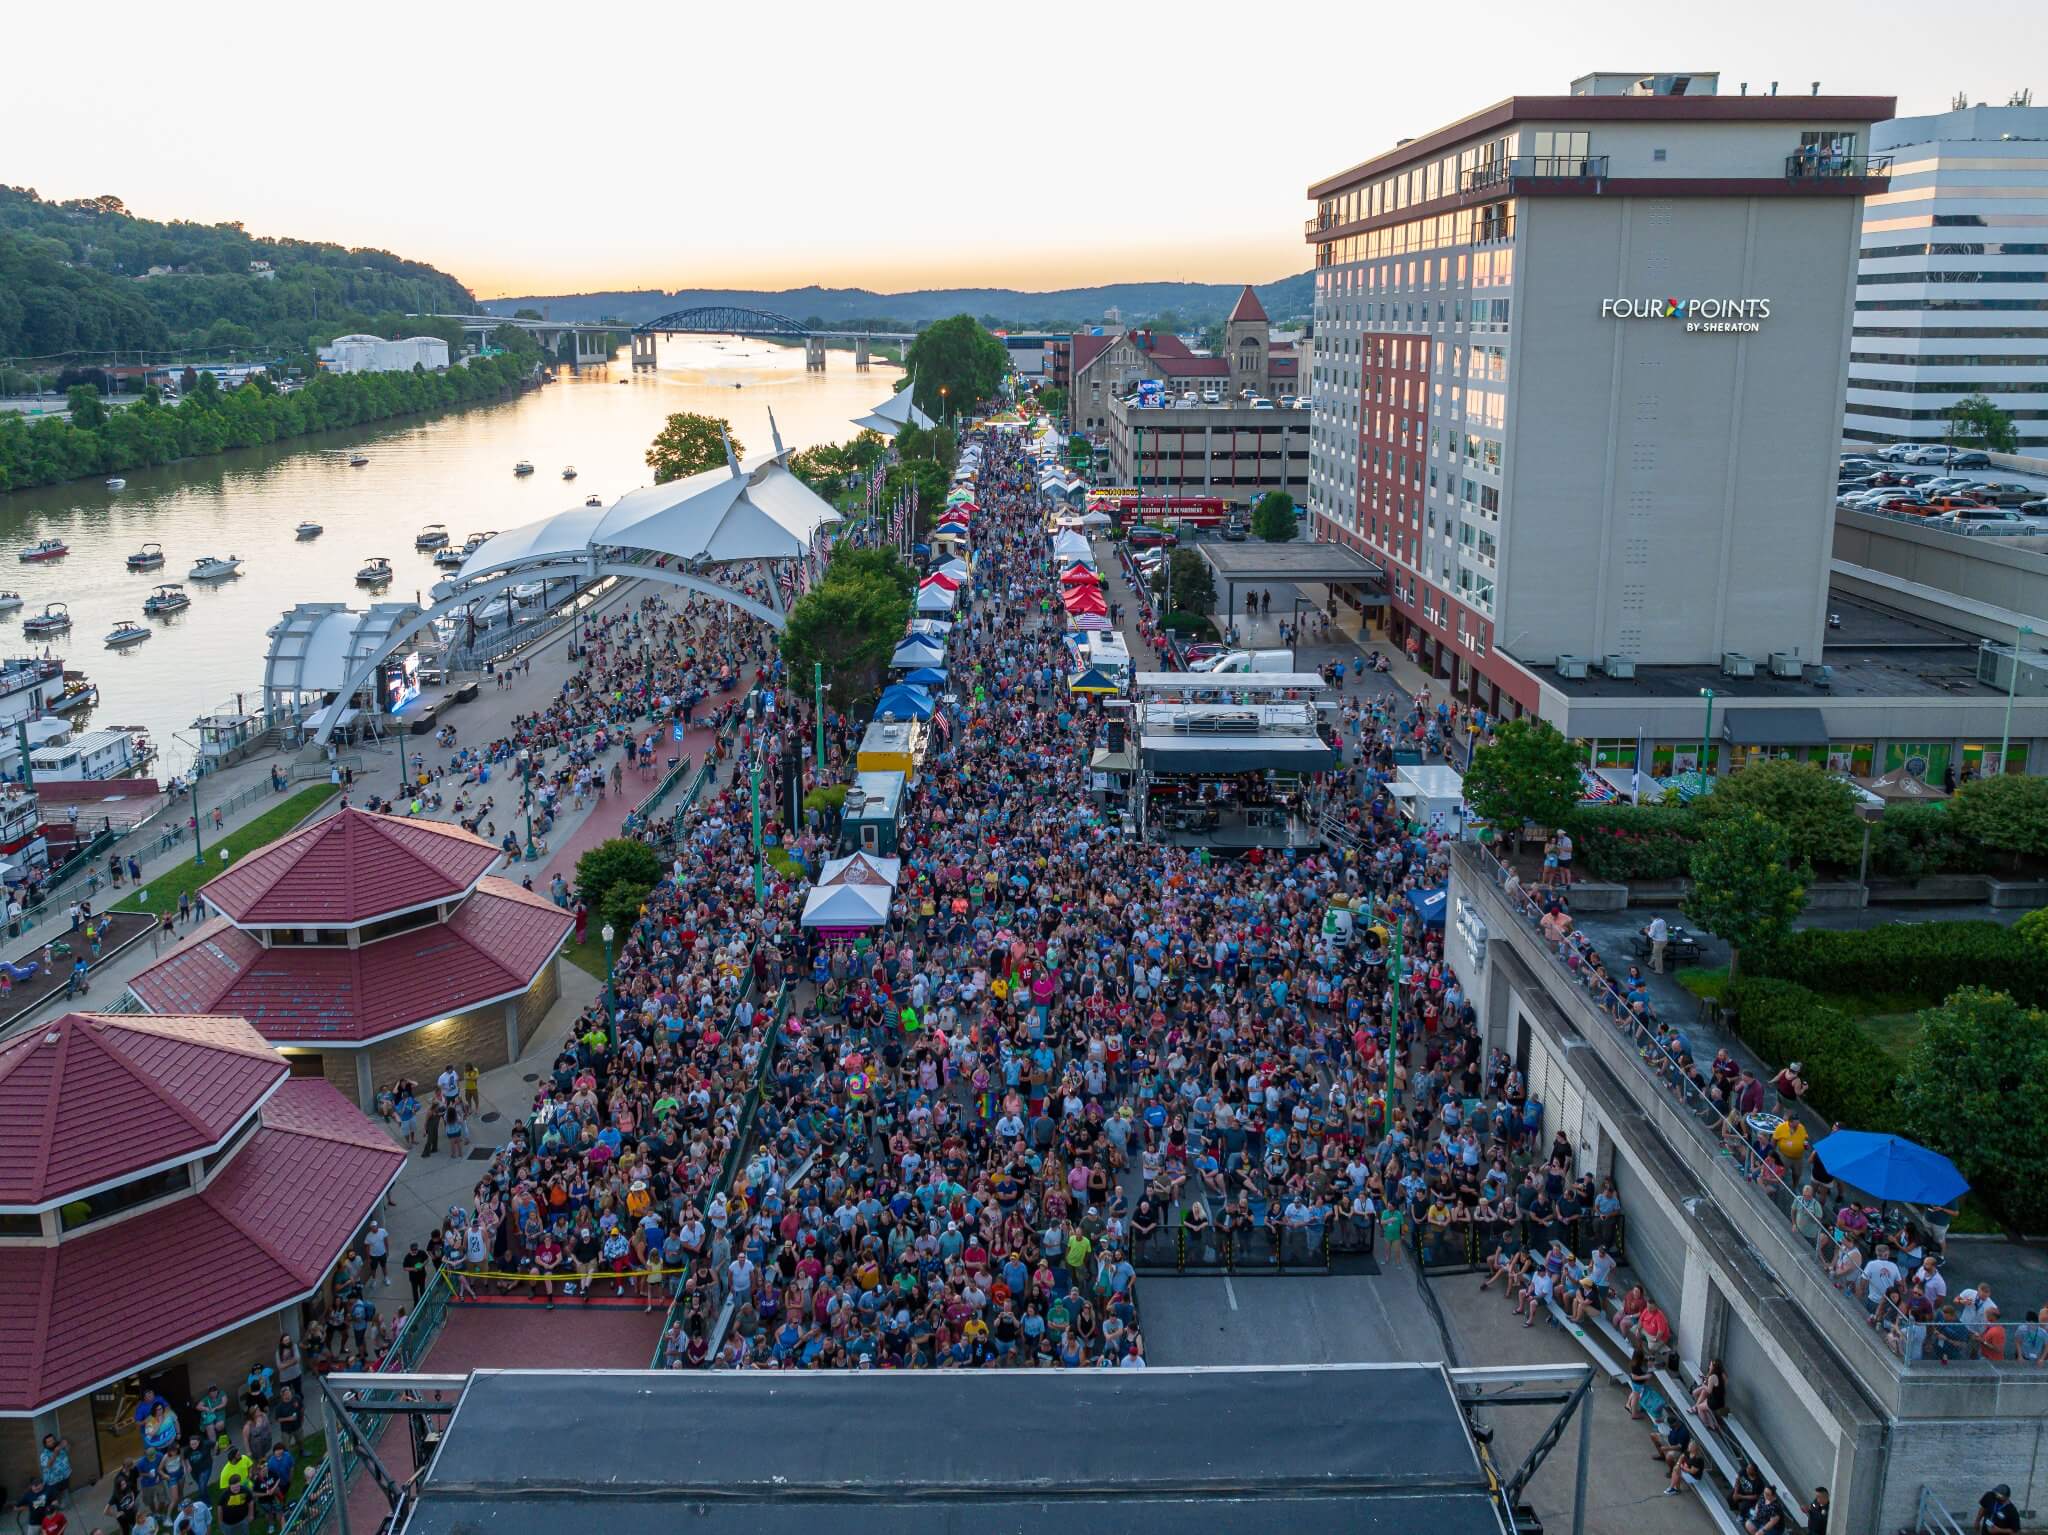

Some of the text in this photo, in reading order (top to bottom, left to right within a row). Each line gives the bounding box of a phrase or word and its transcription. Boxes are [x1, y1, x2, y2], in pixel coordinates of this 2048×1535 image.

[1601, 298, 1770, 318] FOUR POINTS
[1687, 322, 1759, 332] BY SHERATON
